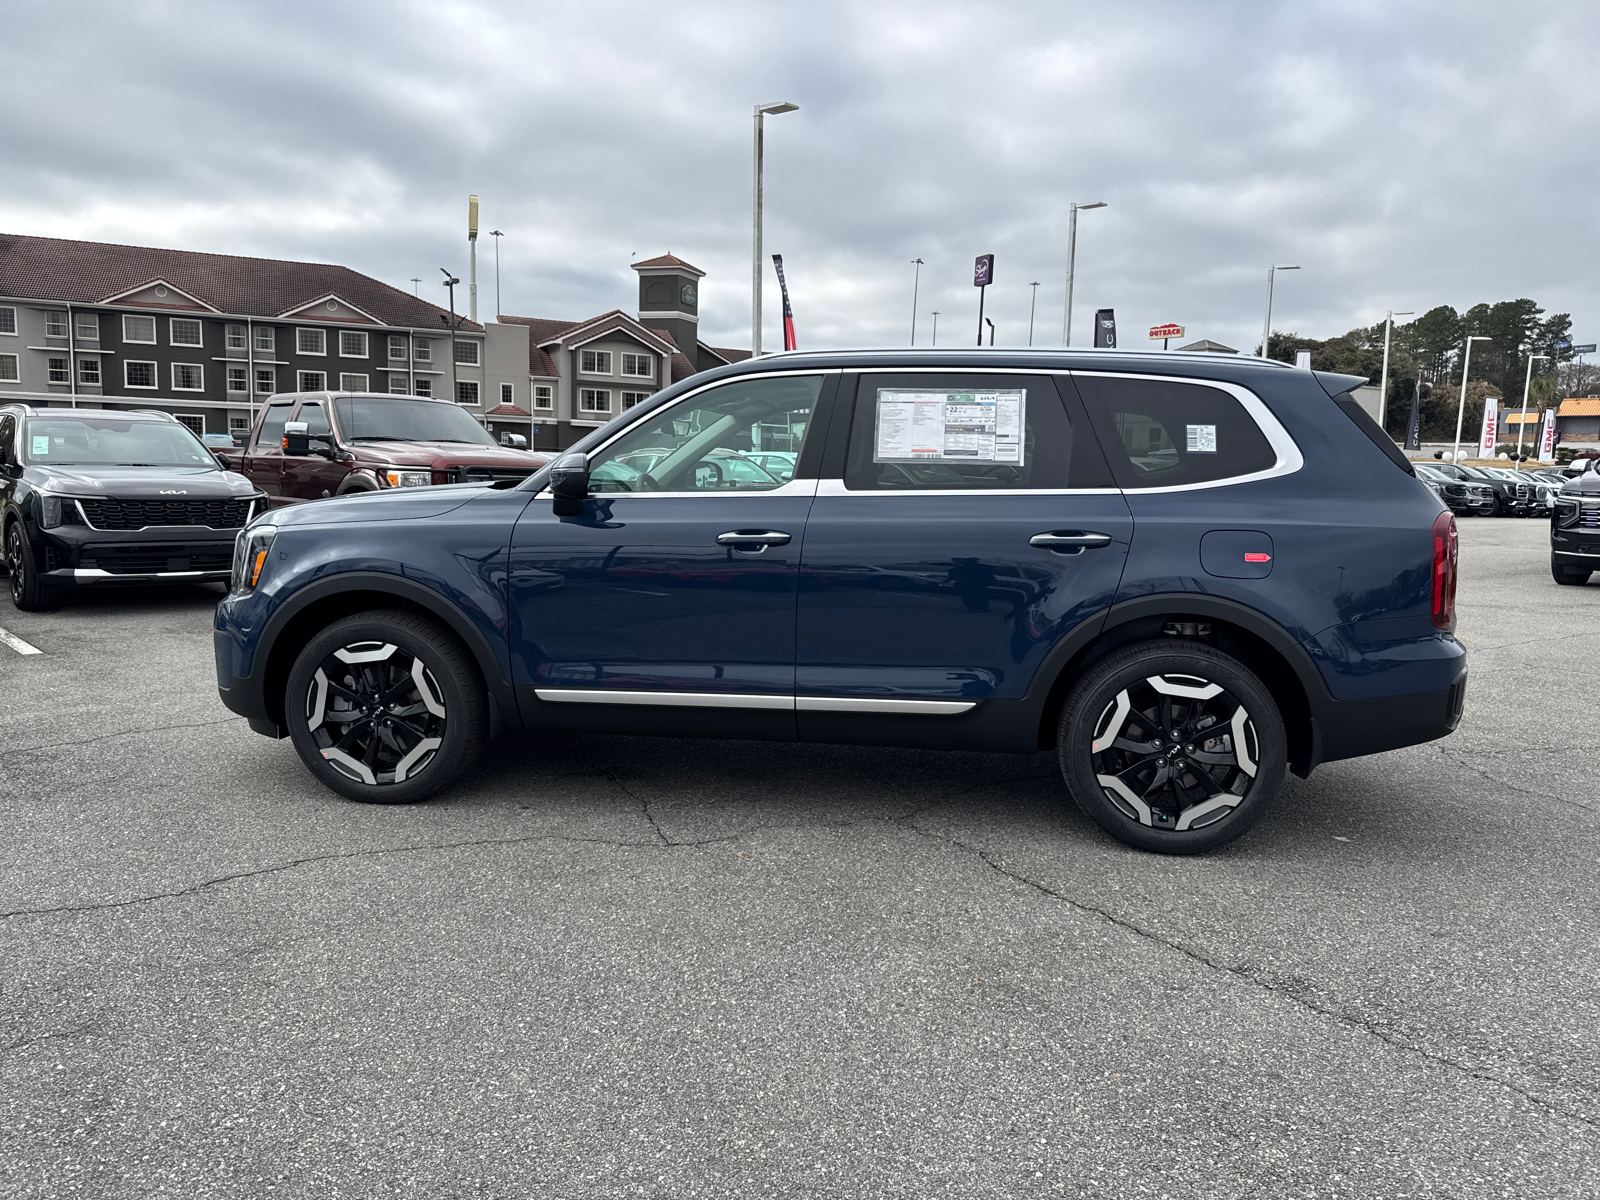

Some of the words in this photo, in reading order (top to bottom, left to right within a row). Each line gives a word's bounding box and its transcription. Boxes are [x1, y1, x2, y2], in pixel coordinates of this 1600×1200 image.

[1149, 328, 1181, 337] OUTBACK
[1484, 410, 1495, 449] GMC
[1543, 419, 1554, 453] GMC
[1083, 675, 1121, 724] CRUGEN
